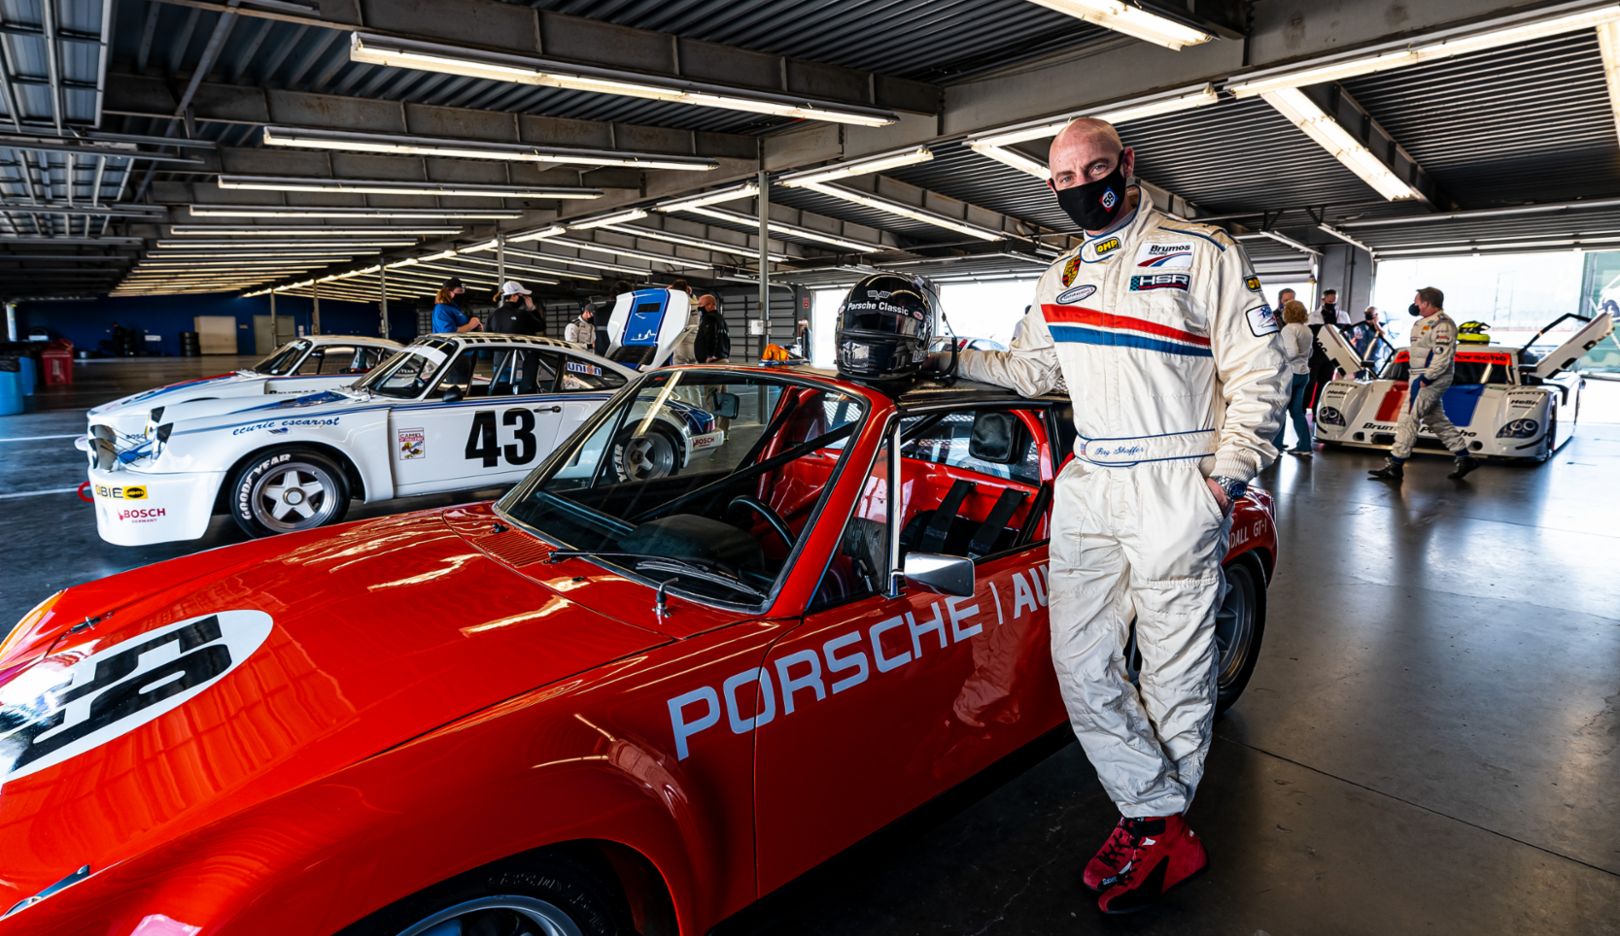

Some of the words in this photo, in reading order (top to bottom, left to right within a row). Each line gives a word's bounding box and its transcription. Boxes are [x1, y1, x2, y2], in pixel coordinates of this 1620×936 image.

[1097, 239, 1118, 253] OMP
[1150, 244, 1191, 252] Brumos
[1140, 275, 1189, 286] HSR
[847, 301, 876, 311] Porsche
[878, 302, 909, 315] Classic
[465, 407, 537, 468] 43
[124, 508, 166, 518] BOSCH
[667, 595, 983, 762] PORSCHE
